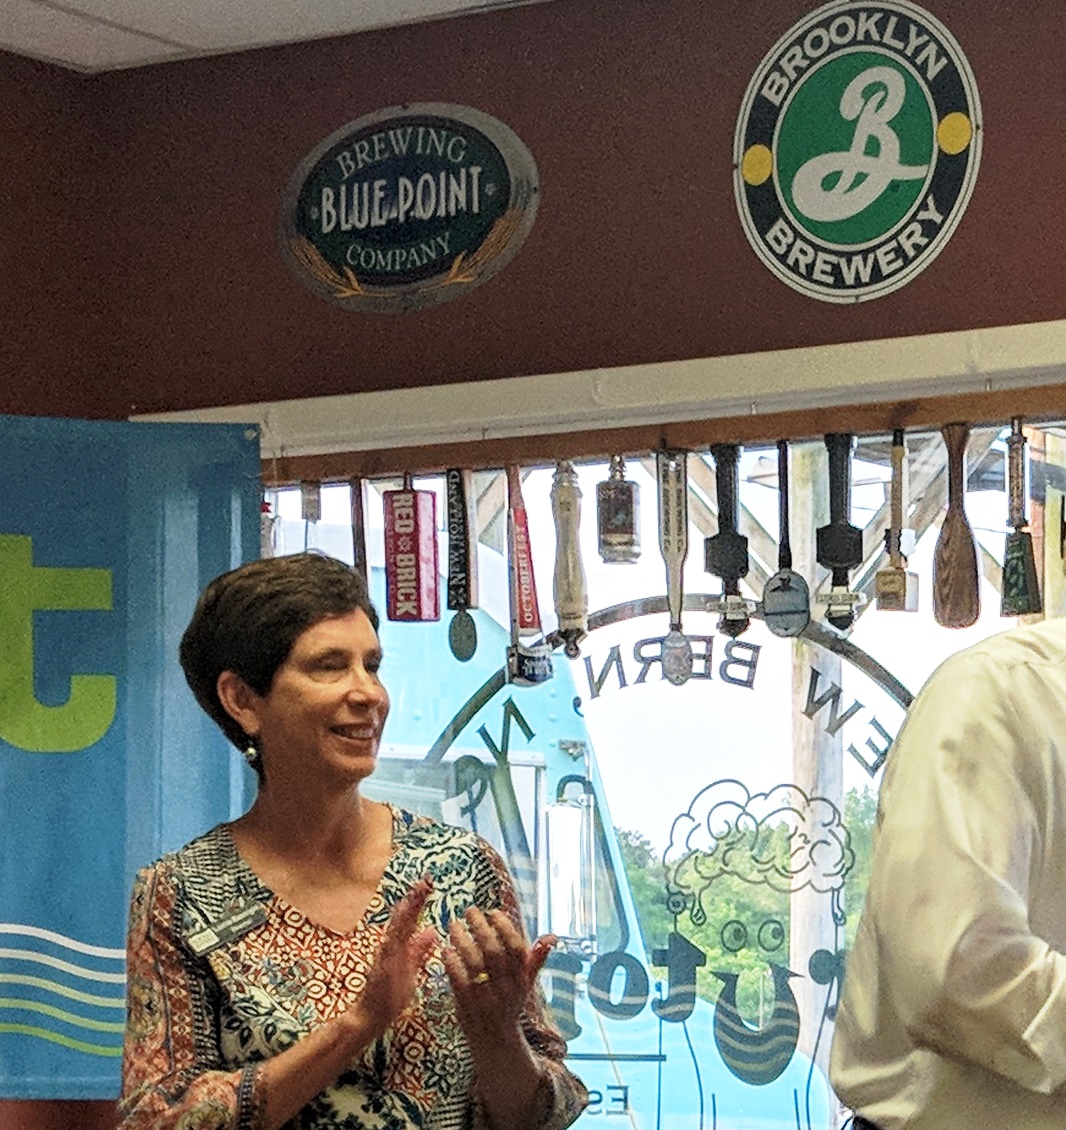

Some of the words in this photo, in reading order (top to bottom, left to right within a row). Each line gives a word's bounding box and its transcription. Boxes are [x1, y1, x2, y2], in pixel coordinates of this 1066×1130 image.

[760, 12, 948, 107] BROOKLYN
[336, 127, 467, 179] BREWING
[321, 179, 388, 234] BLUE
[398, 166, 482, 224] POINT
[346, 232, 451, 271] COMPANY
[765, 194, 944, 286] BREWERY
[392, 493, 415, 534] RED
[396, 553, 417, 616] BRICK
[515, 525, 534, 623] OCTOBERFEST
